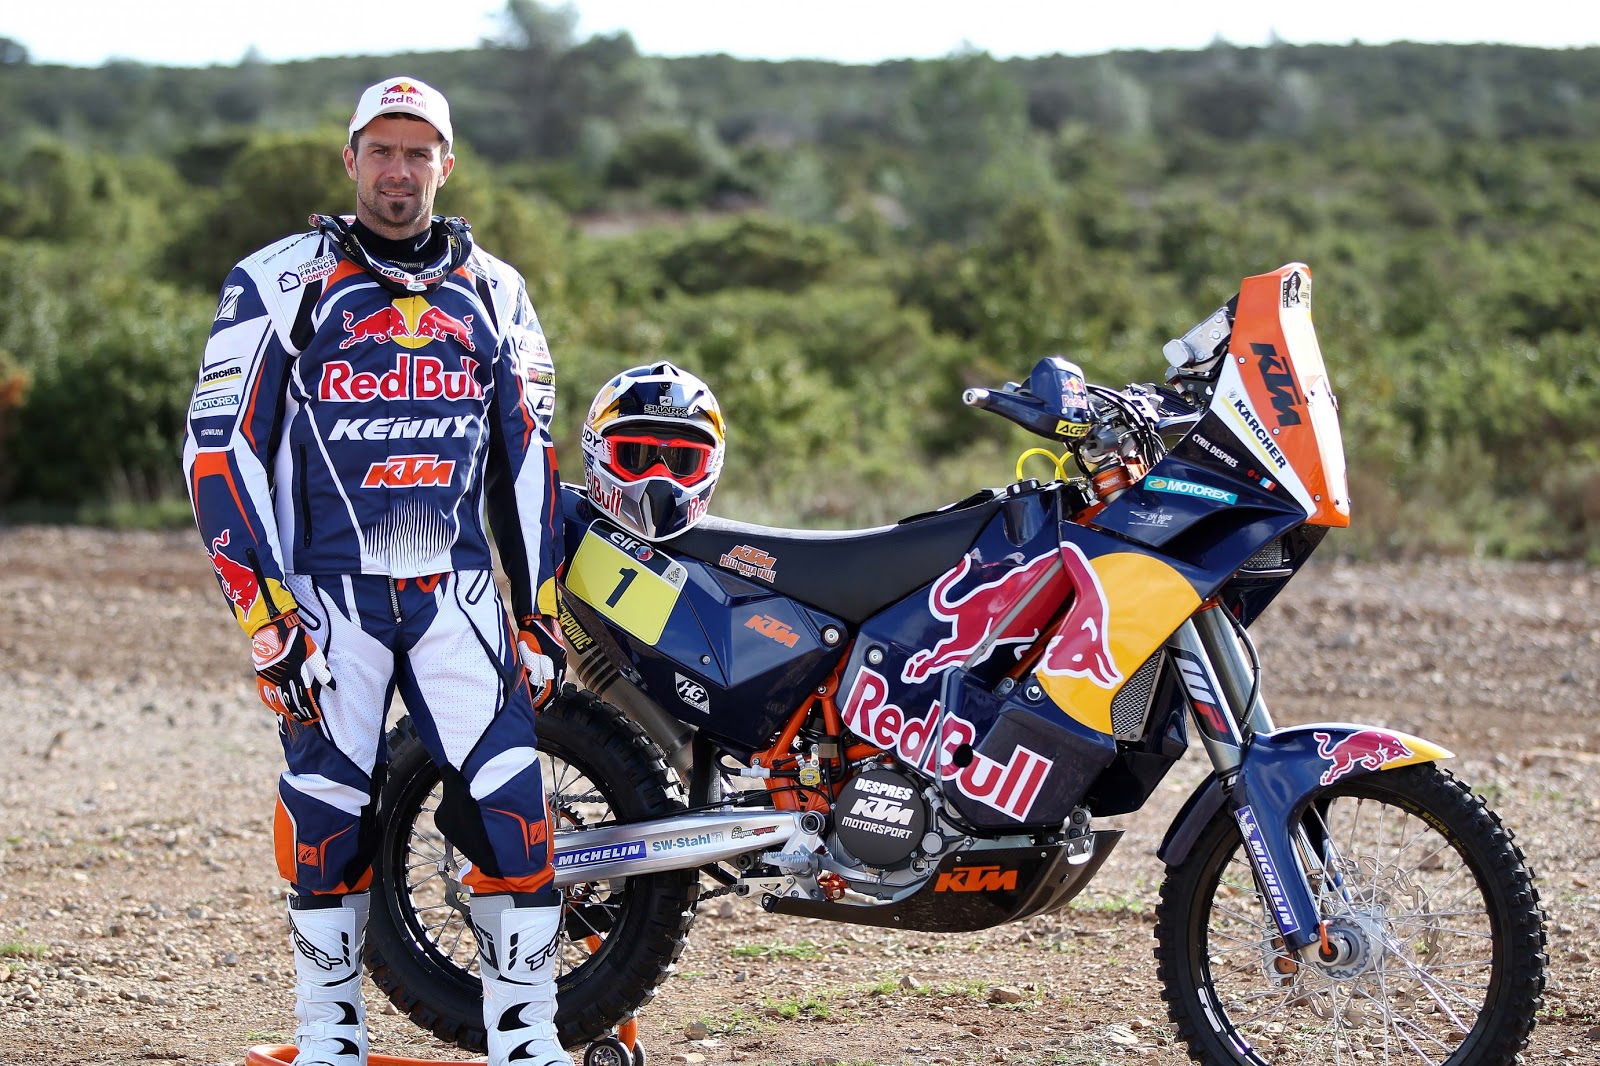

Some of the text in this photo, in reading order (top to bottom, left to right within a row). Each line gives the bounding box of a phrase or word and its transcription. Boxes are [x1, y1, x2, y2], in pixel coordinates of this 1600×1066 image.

[381, 95, 426, 110] Red Bull
[297, 252, 334, 272] maisons
[299, 258, 336, 278] FRANCE
[301, 265, 337, 284] CONFORT
[415, 268, 442, 281] GAMES
[318, 353, 486, 402] Red Bull
[1249, 342, 1302, 427] KTM
[194, 395, 237, 411] MOTOREX
[643, 404, 688, 416] SHARK
[328, 413, 474, 441] KENNY
[1233, 399, 1287, 470] KÄRCHER
[1192, 434, 1239, 468] CYRIL DESPRES
[360, 454, 456, 489] KTM
[593, 475, 622, 518] Bull
[1166, 480, 1233, 501] MOTOREX
[610, 532, 641, 550] elf
[728, 544, 777, 570] KTM
[605, 567, 638, 608] 1
[744, 614, 800, 648] KTM
[679, 681, 704, 701] HG
[841, 666, 1053, 822] Red Bull
[854, 778, 913, 800] DESPRES
[850, 796, 914, 825] KTM
[841, 817, 912, 839] MOTORSPORT
[558, 845, 640, 865] MICHELIN
[650, 834, 711, 852] SW-Stahl
[934, 866, 1018, 892] KTM
[1250, 840, 1293, 925] MICHELIN
